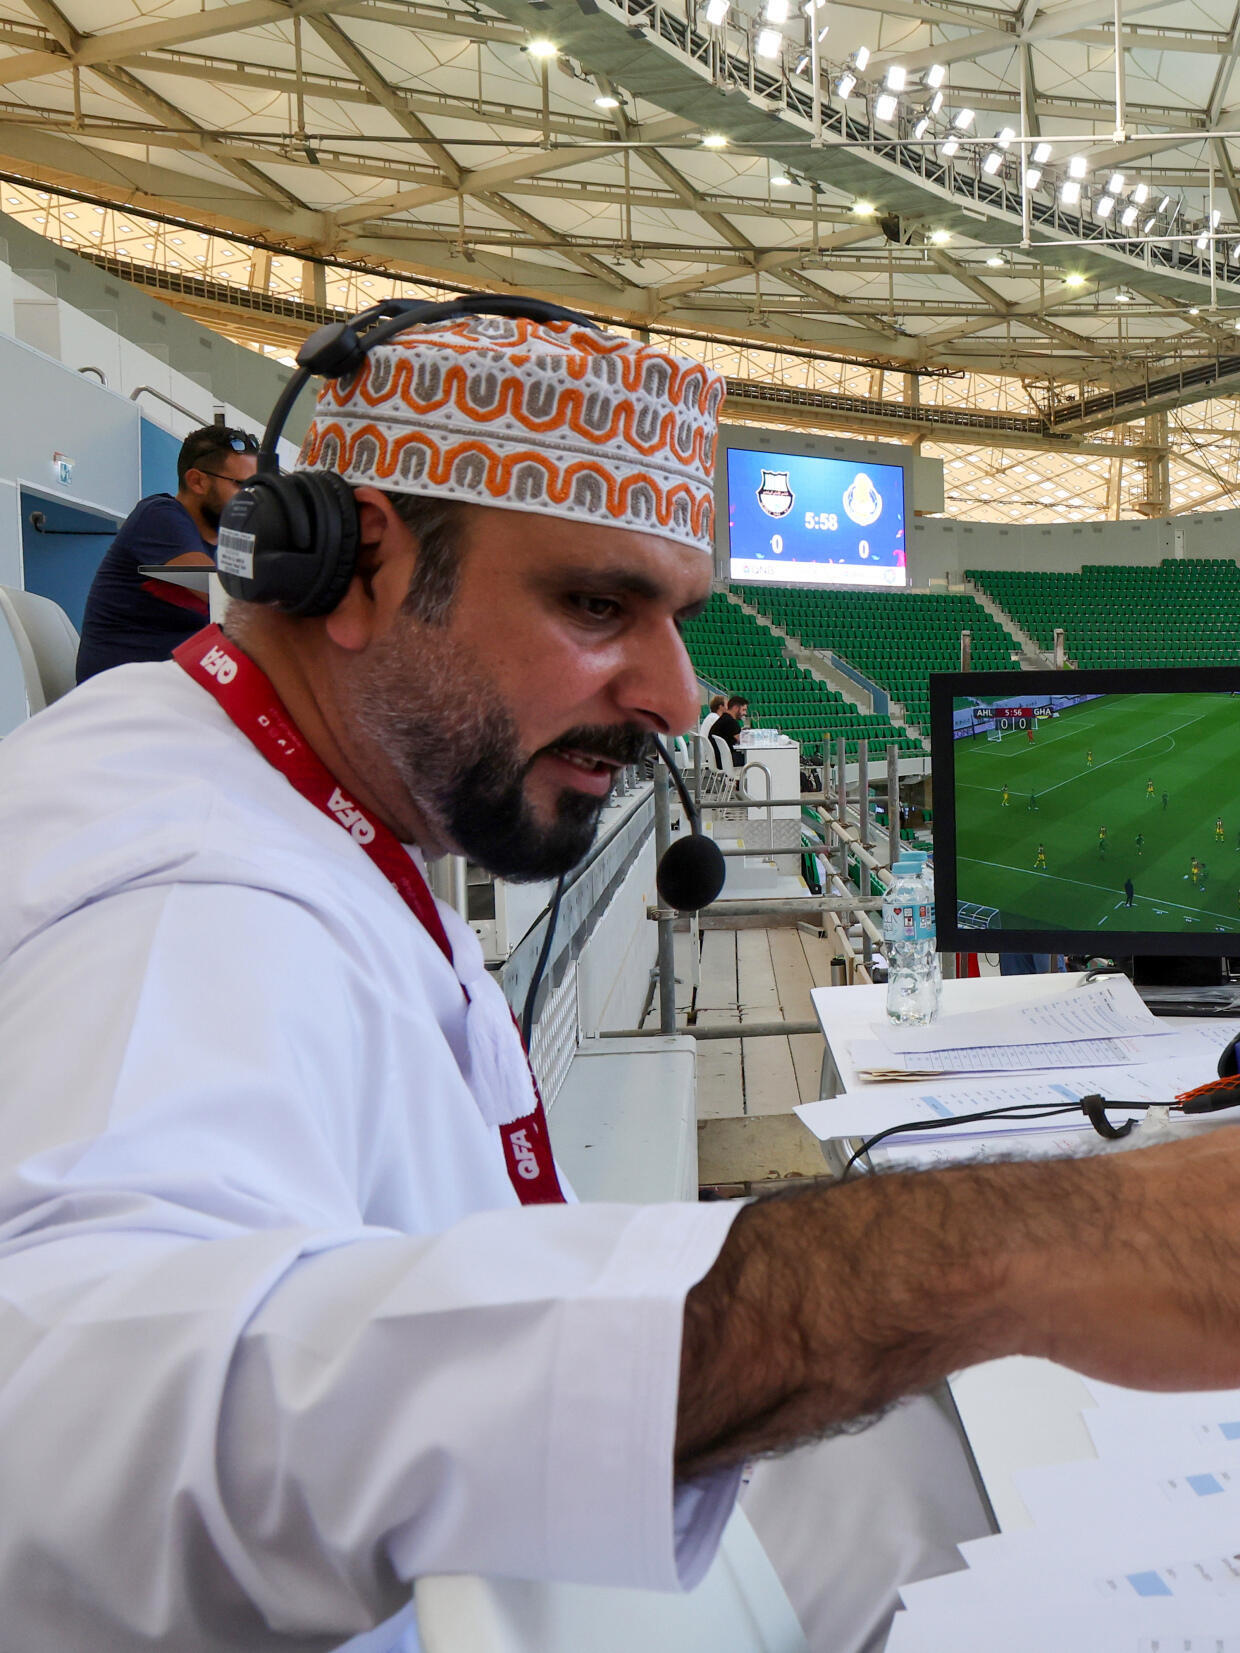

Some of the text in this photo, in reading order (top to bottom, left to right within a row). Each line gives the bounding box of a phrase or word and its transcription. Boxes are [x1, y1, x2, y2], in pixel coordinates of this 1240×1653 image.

[804, 511, 838, 531] 5:58
[771, 534, 783, 554] 0
[858, 540, 870, 559] 0
[199, 645, 239, 685] QFA
[977, 709, 993, 717] AHL
[1033, 708, 1051, 716] GHA
[1001, 718, 1008, 729] 0
[1019, 718, 1026, 729] 0
[326, 786, 377, 846] QFA
[509, 1128, 540, 1180] QFA
